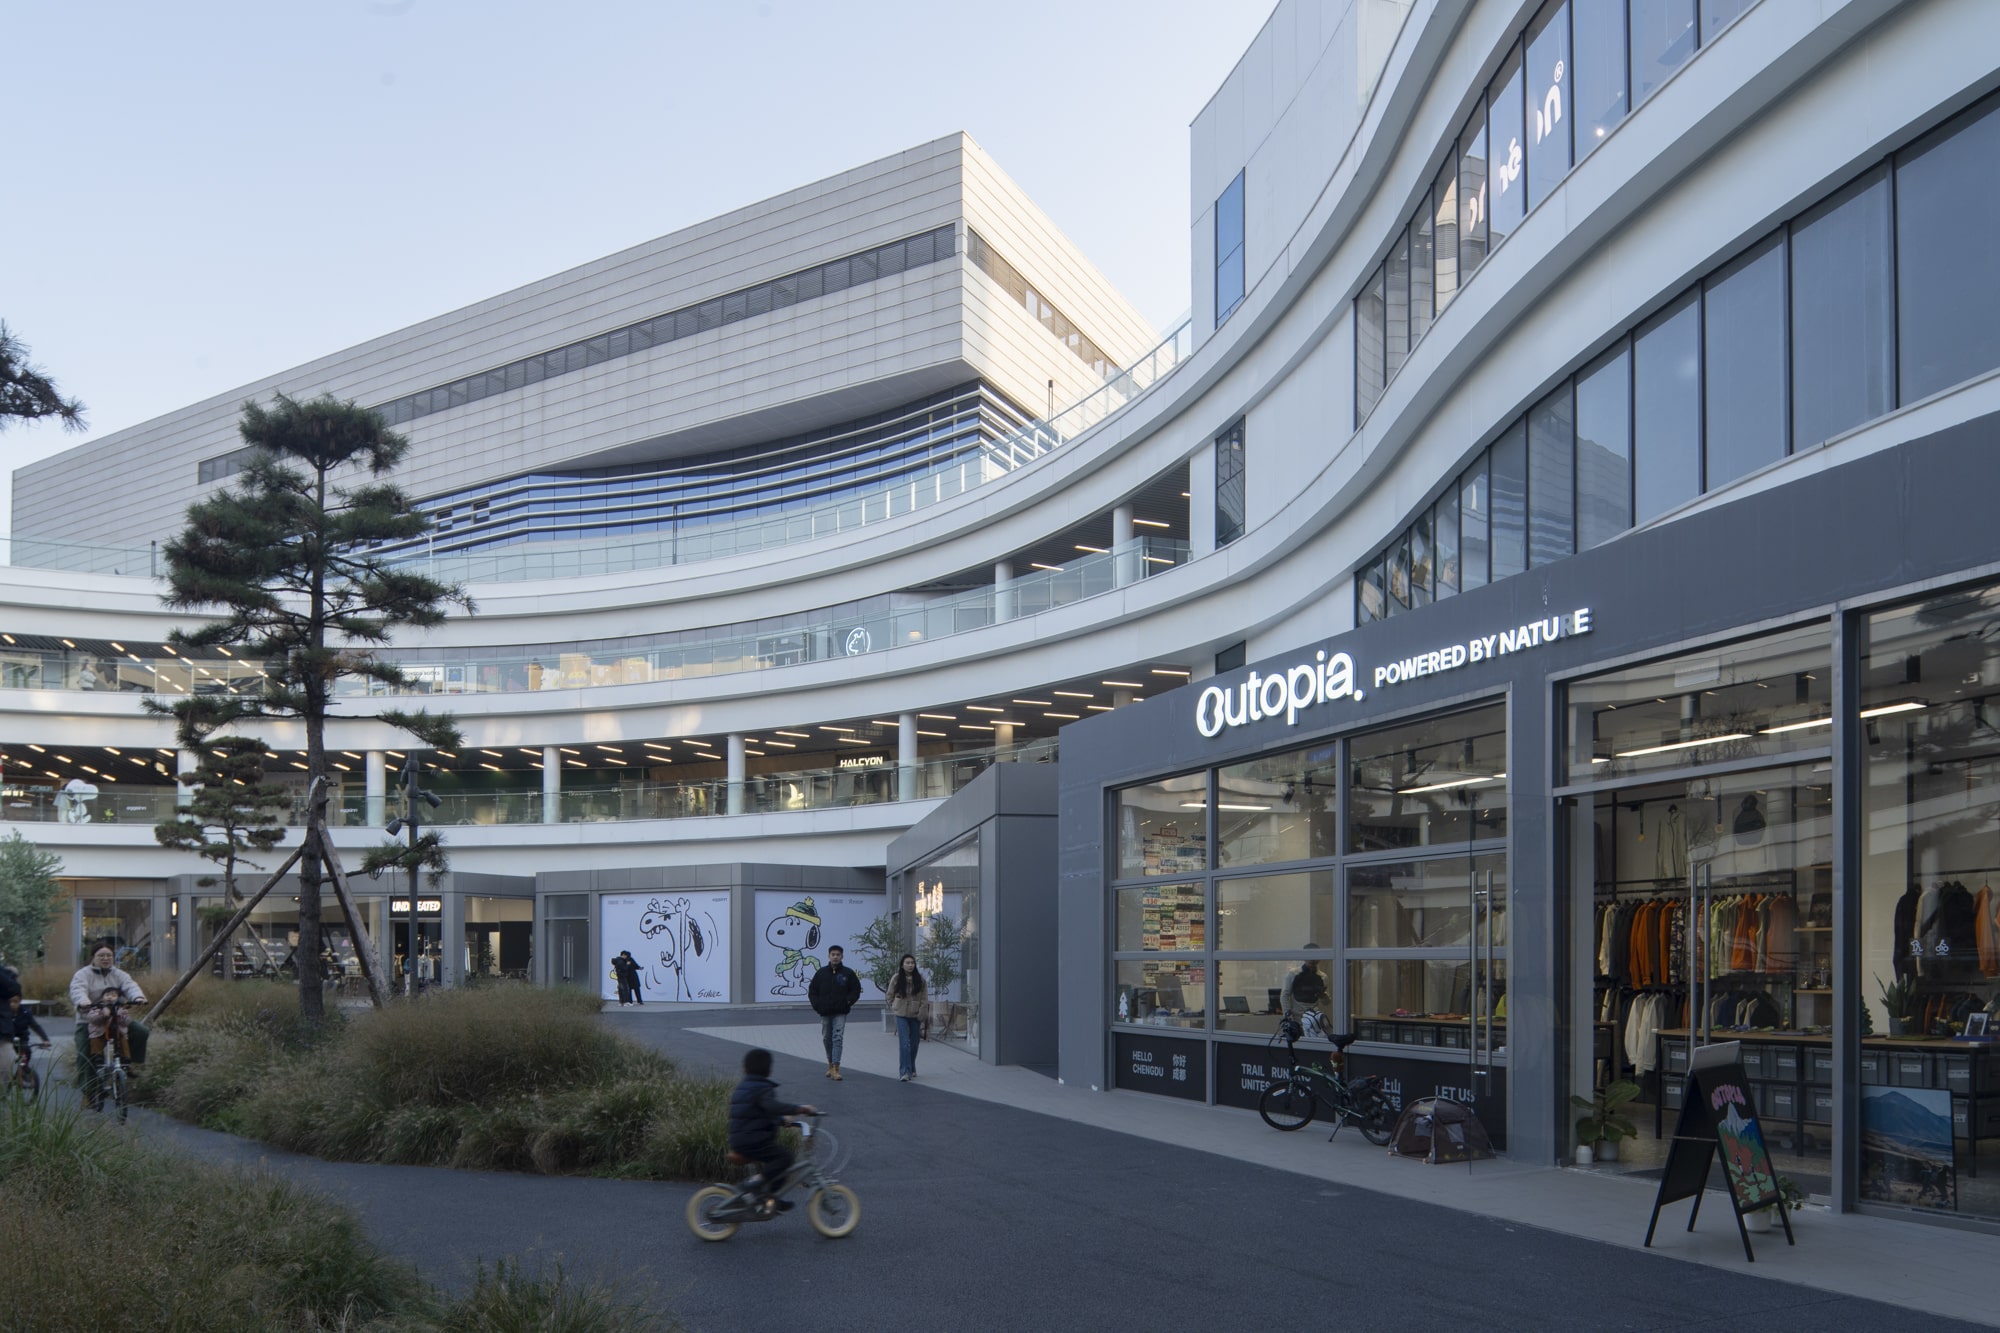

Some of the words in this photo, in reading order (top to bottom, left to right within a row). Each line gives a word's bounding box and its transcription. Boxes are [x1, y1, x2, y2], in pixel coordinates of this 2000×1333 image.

[1375, 644, 1467, 688] POWERED
[1469, 634, 1498, 663] BY
[1498, 607, 1593, 656] NATURE
[839, 756, 884, 768] HALCYON
[1132, 1050, 1153, 1063] HELLO
[1172, 1054, 1187, 1068] 你好
[1132, 1063, 1164, 1078] CHENGDU
[1172, 1068, 1187, 1082] 成都
[1241, 1063, 1265, 1077] TRAIL
[1435, 1084, 1456, 1100] LET
[1458, 1087, 1476, 1104] US
